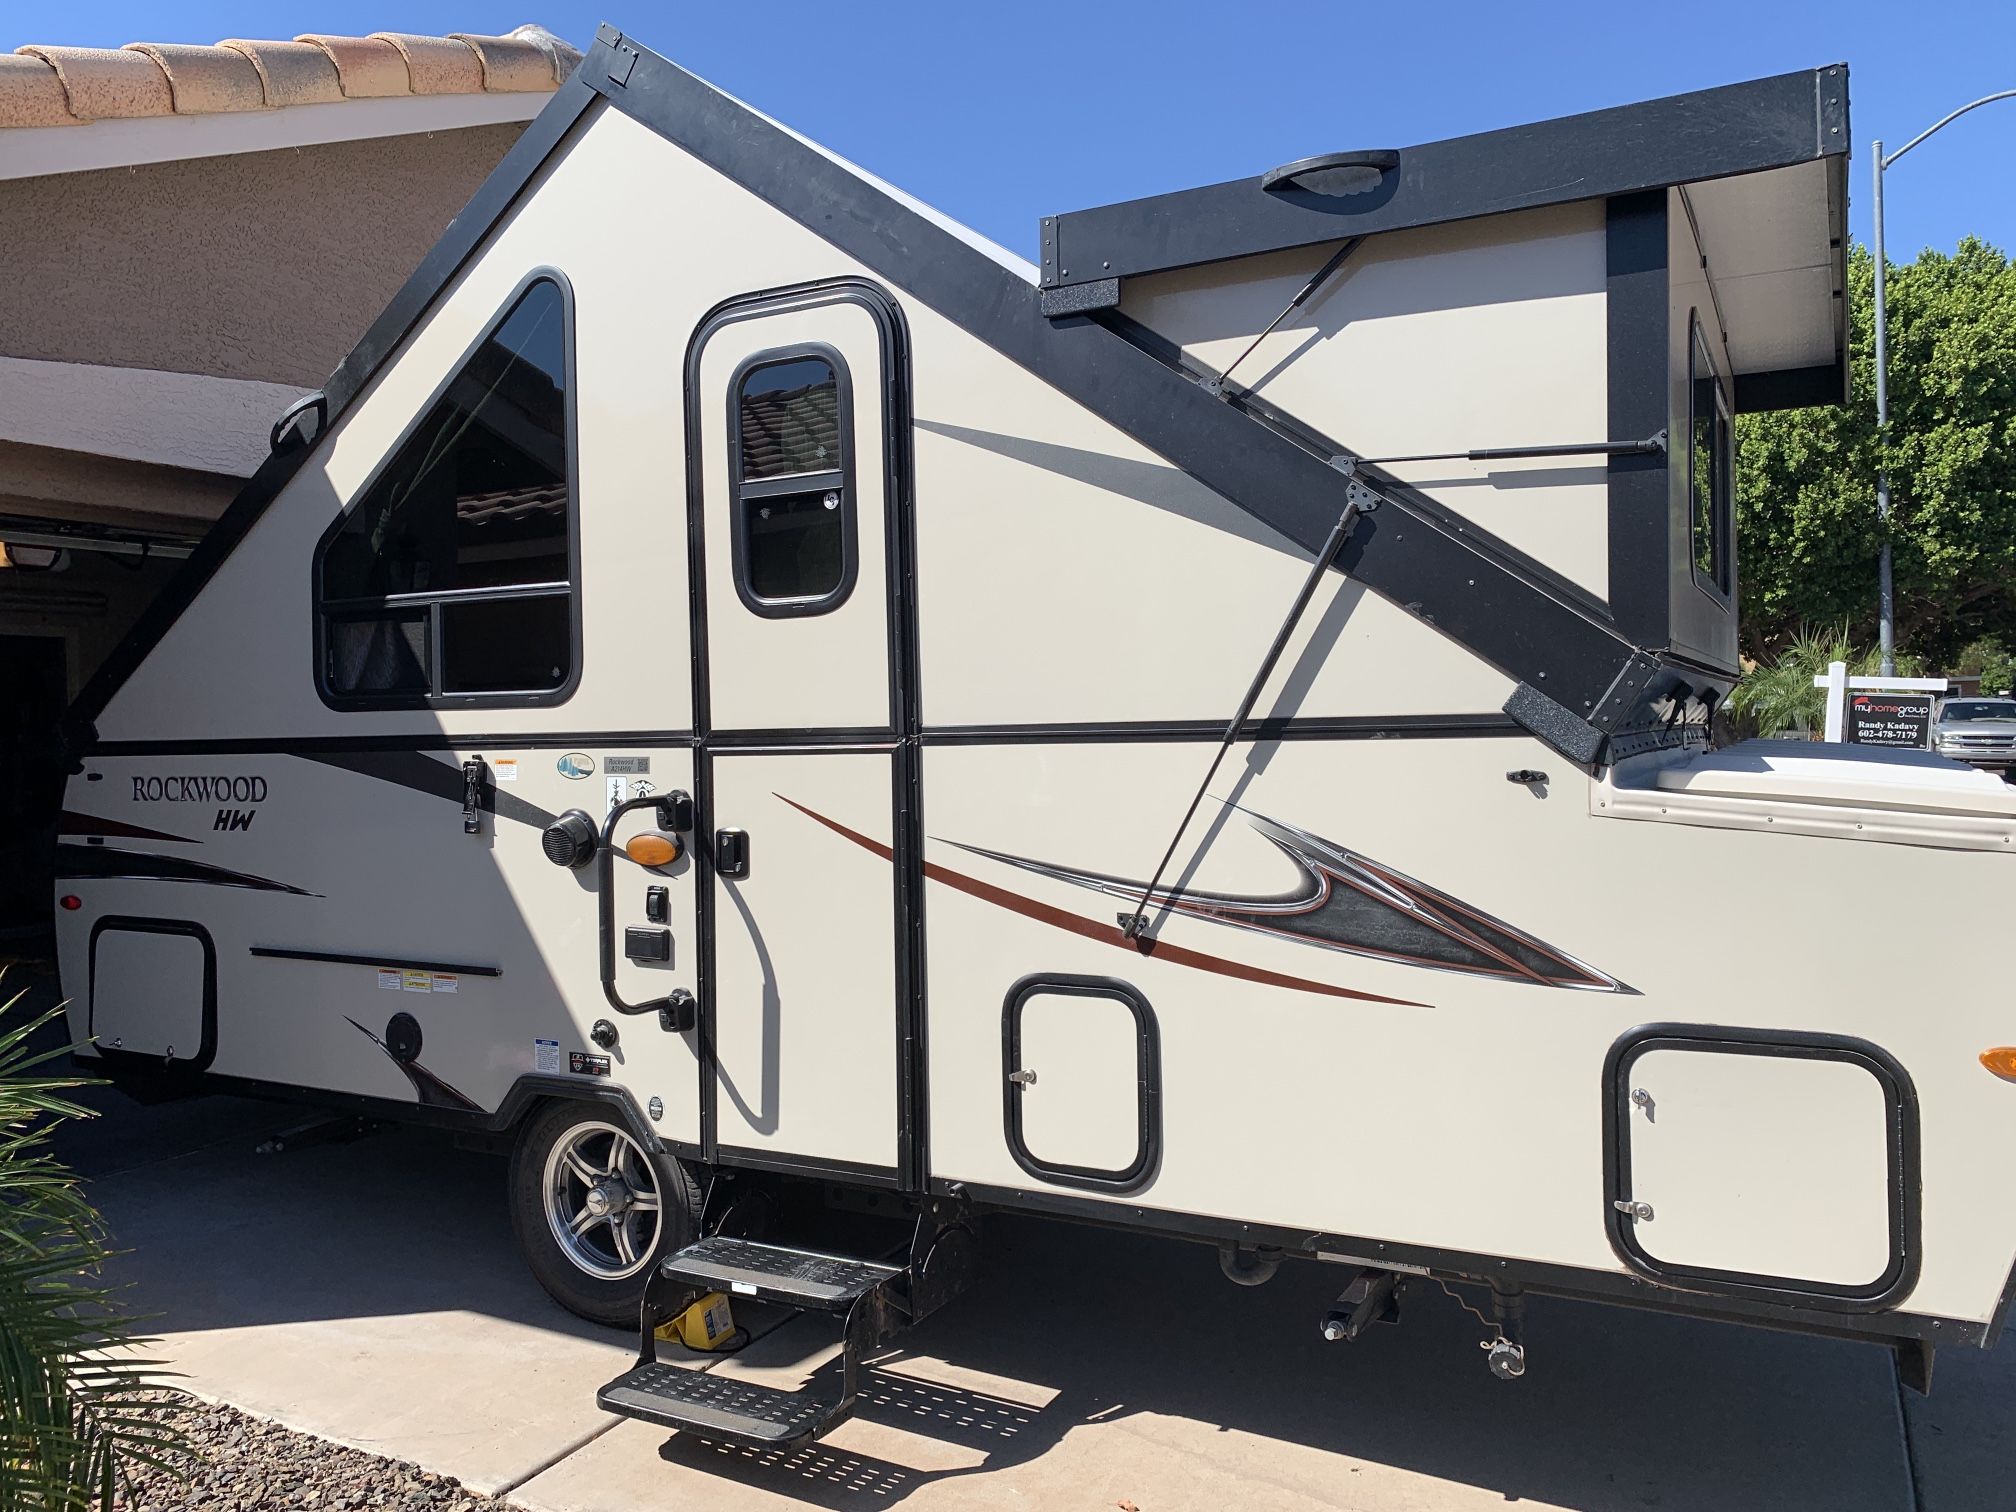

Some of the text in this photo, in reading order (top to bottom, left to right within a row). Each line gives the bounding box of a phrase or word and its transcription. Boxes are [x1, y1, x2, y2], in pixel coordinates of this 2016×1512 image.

[1854, 704, 1929, 718] myhomegroup
[1858, 721, 1919, 732] Randy Kadavy
[1858, 730, 1918, 739] 602-478-7179
[608, 758, 634, 766] Rockwood
[131, 776, 267, 802] ROCKWOOD
[213, 809, 256, 831] HW
